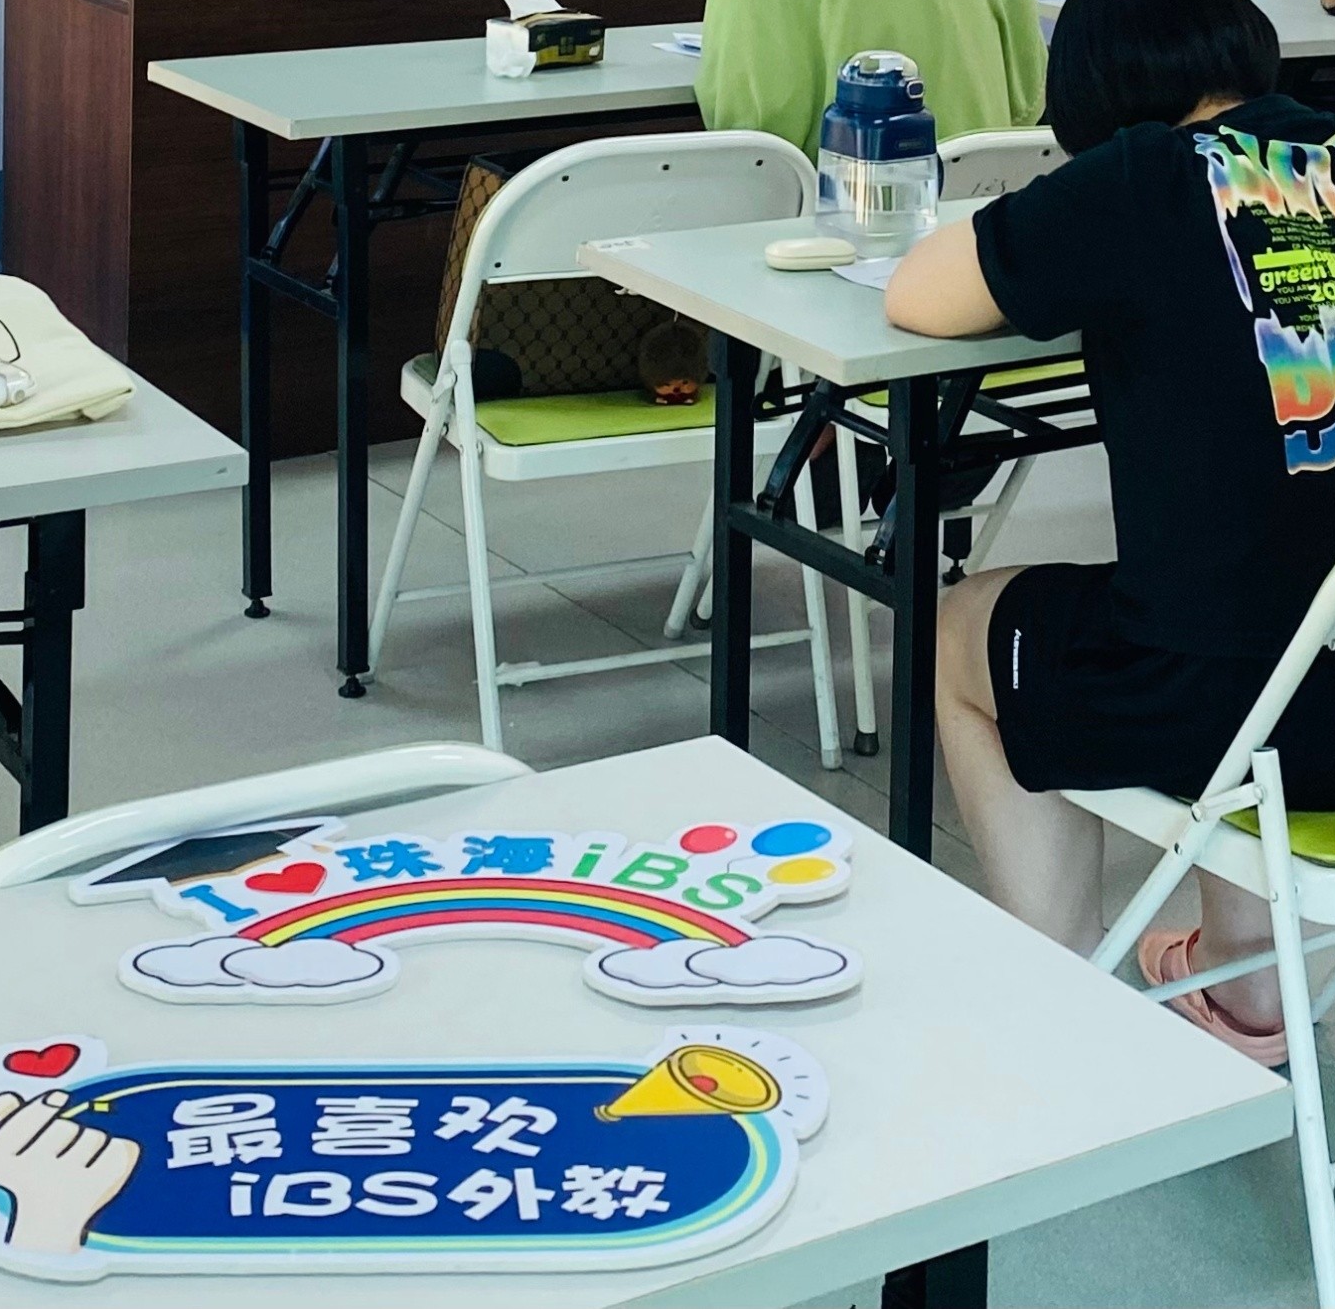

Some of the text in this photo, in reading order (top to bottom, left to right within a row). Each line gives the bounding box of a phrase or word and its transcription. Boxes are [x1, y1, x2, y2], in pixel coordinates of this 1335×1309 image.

[1259, 265, 1327, 292] green
[335, 833, 555, 882] 珠海
[570, 842, 763, 911] iBS
[166, 1094, 559, 1170] 最喜欢
[228, 1165, 671, 1222] iBS外教
